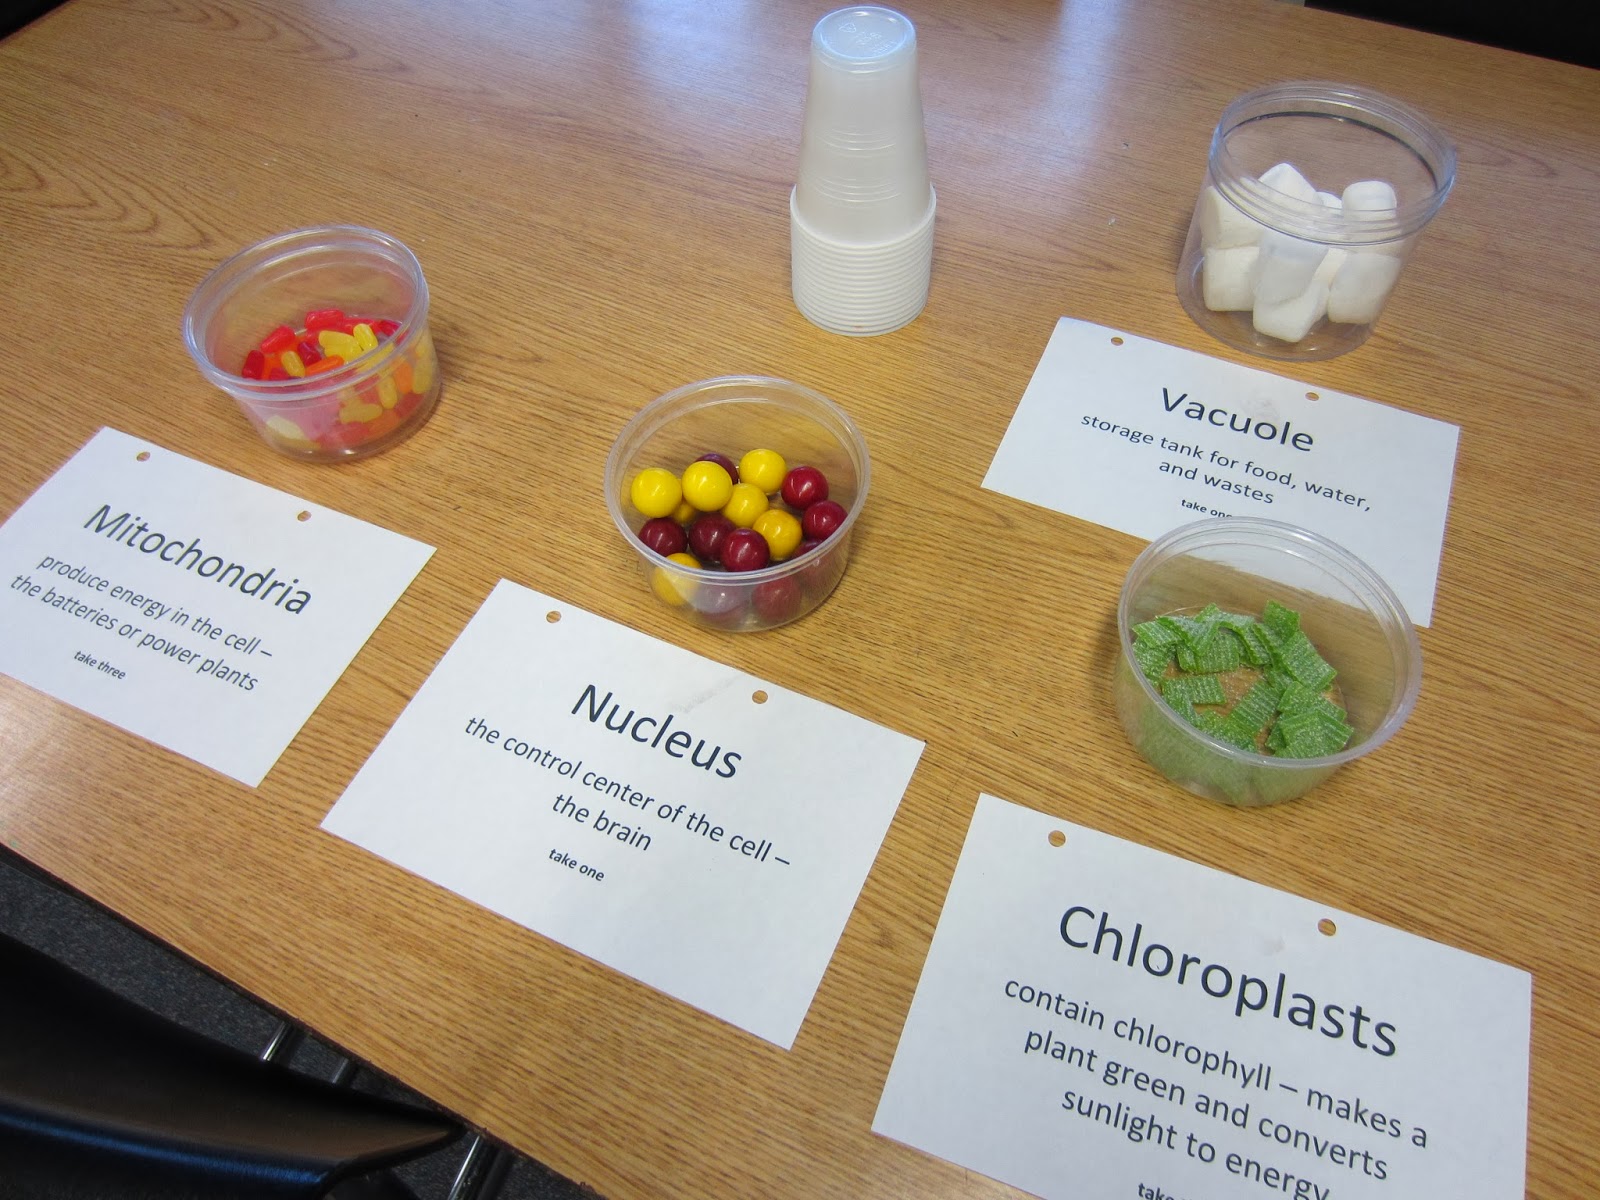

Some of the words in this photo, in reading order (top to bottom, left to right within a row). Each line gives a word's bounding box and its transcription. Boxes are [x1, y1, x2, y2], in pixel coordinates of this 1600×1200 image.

[1081, 416, 1153, 444] storage
[1161, 437, 1203, 459] tank
[1210, 451, 1239, 468] for
[1245, 461, 1296, 489] food,
[1305, 482, 1370, 511] water,
[1163, 388, 1313, 451] Vacuole
[1159, 462, 1198, 480] and
[1204, 475, 1273, 503] wastes
[1181, 499, 1208, 514] take
[36, 557, 109, 591] produce
[110, 586, 171, 620] energy
[170, 608, 189, 626] in
[191, 617, 222, 640] the
[224, 634, 261, 654] cell
[84, 505, 311, 614] Mitochondria
[11, 575, 41, 596] the
[41, 587, 118, 629] batteries
[119, 624, 142, 639] or
[137, 633, 201, 664] power
[196, 659, 258, 690] plants
[74, 651, 97, 666] take
[98, 661, 125, 679] three
[571, 684, 742, 778] Nucleus
[465, 718, 500, 744] the
[504, 738, 582, 779] control
[583, 772, 655, 810] center
[657, 805, 687, 822] of
[686, 813, 724, 842] the
[730, 835, 772, 862] cell
[553, 794, 589, 823] the
[593, 810, 651, 851] brain
[549, 849, 577, 869] take
[579, 865, 604, 881] one
[1060, 906, 1396, 1057] Chloroplasts
[1005, 981, 1104, 1030] contain
[1114, 1018, 1271, 1091] chlorophyll
[1307, 1089, 1400, 1138] makes
[1412, 1128, 1426, 1148] a
[1024, 1031, 1097, 1072] plant
[1103, 1061, 1185, 1105] green
[1195, 1094, 1249, 1129] and
[1259, 1118, 1386, 1180] converts
[1062, 1091, 1177, 1149] sunlight
[1187, 1133, 1215, 1163] to
[1226, 1153, 1329, 1200] energy
